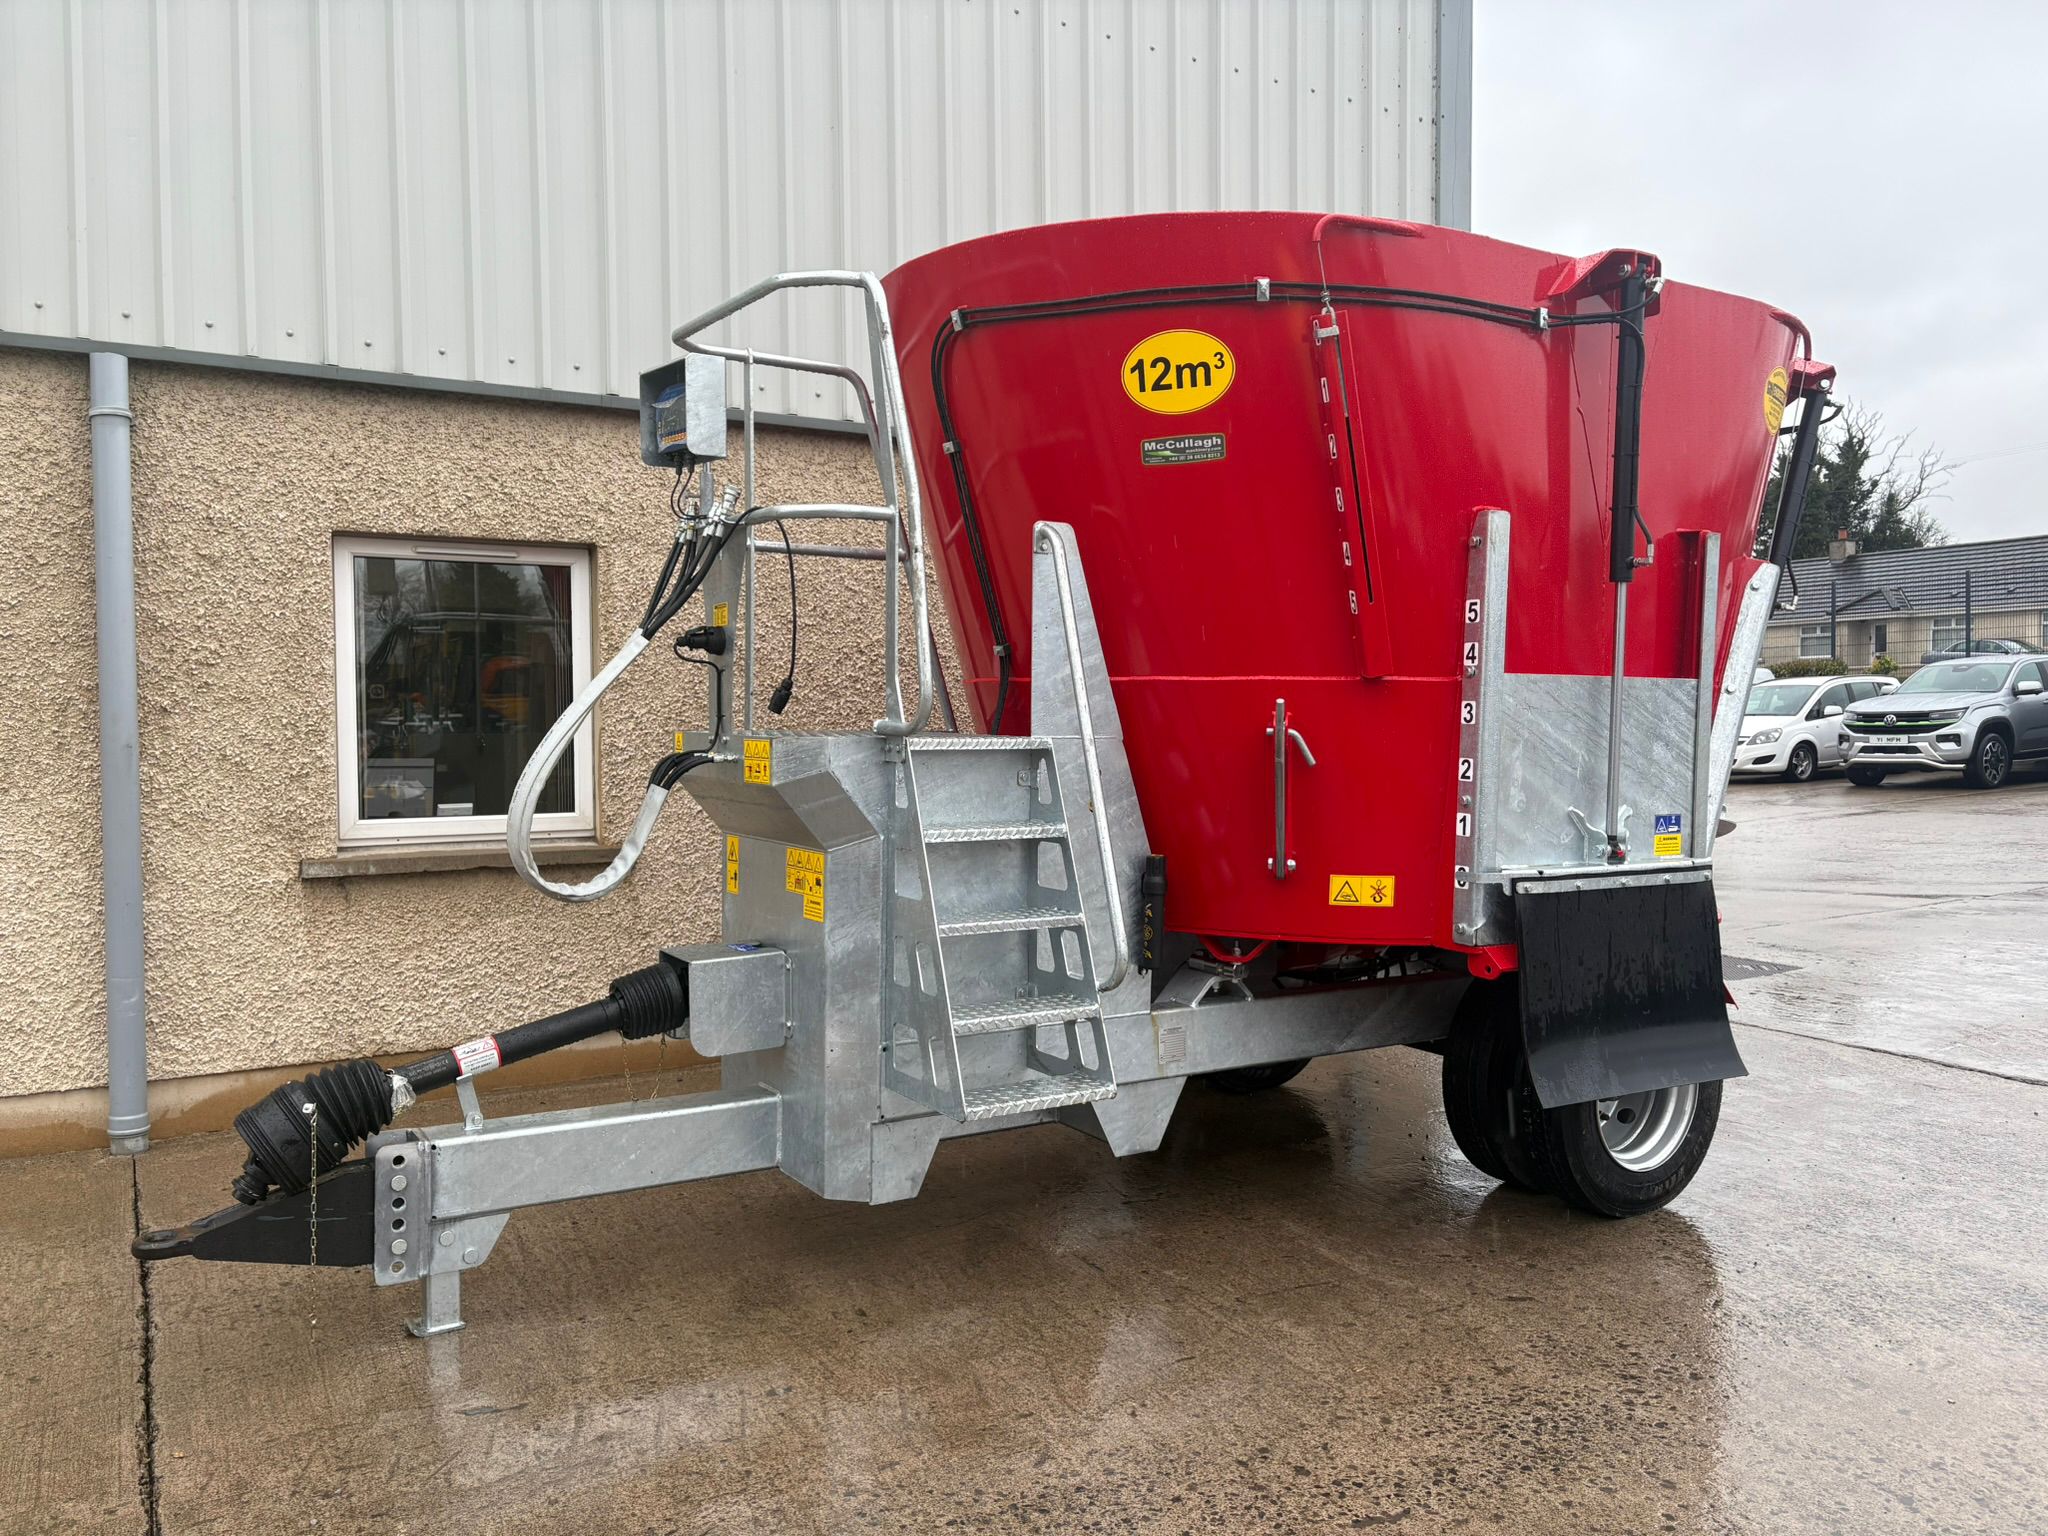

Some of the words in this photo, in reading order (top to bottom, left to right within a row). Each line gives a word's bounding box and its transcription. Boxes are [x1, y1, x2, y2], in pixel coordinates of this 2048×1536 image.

[1322, 378, 1329, 402] 1
[1144, 436, 1222, 451] McCullagh
[1329, 434, 1337, 458] 2
[1337, 488, 1343, 511] 3
[1345, 543, 1351, 565] 4
[1351, 592, 1357, 613] 5
[1467, 601, 1479, 623] 5
[1465, 643, 1477, 664] 4
[1463, 702, 1474, 723] 3
[1460, 759, 1471, 780] 2
[1459, 815, 1467, 836] 1
